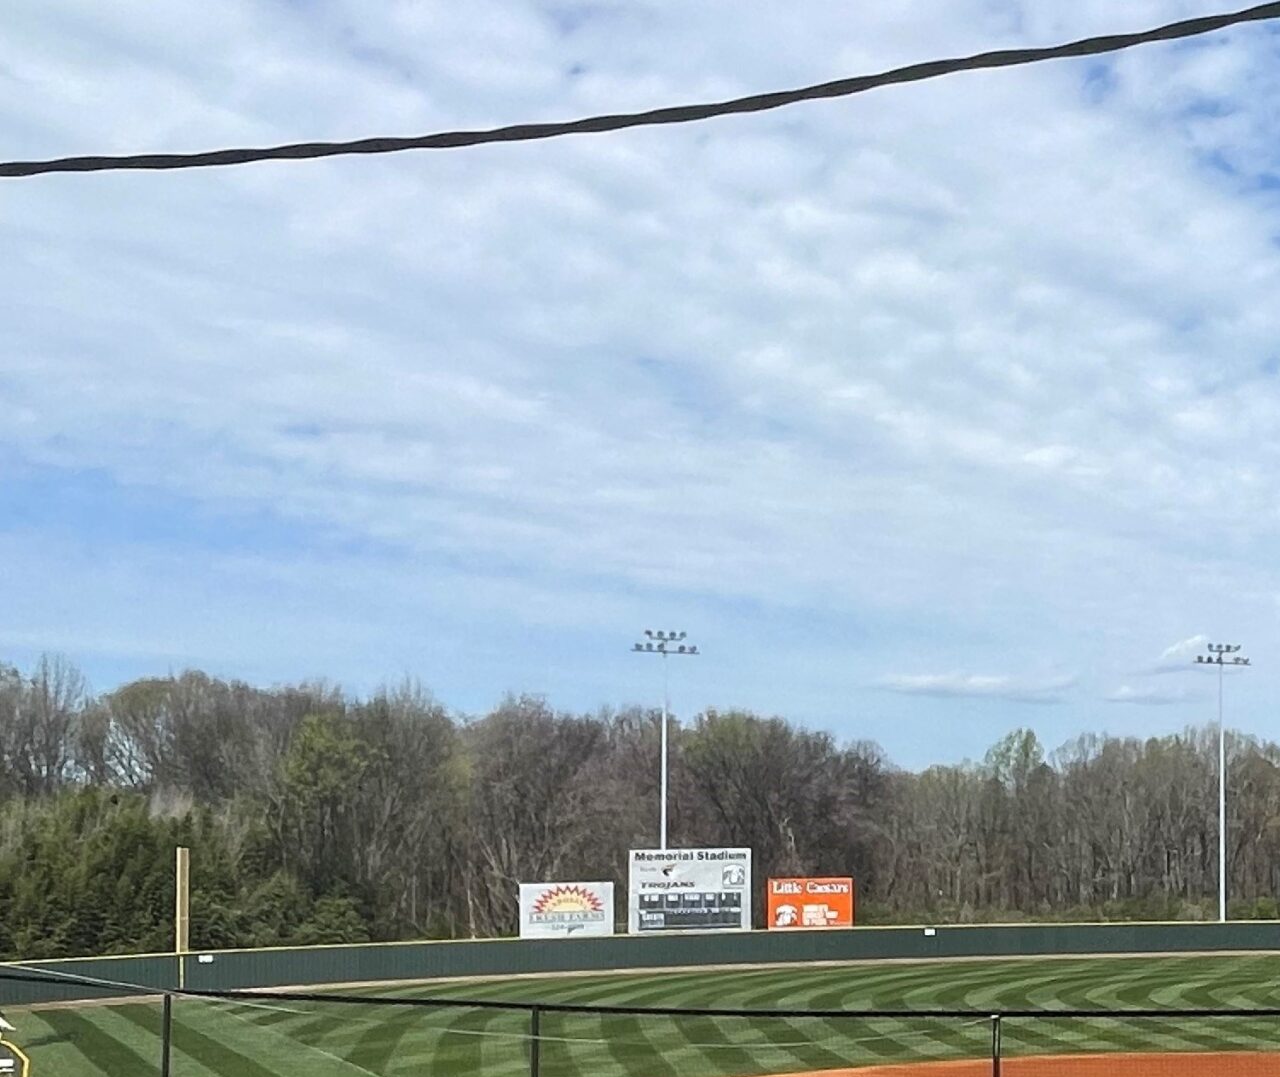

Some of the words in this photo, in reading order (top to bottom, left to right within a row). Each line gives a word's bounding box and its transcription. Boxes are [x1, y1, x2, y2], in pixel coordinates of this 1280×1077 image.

[634, 851, 694, 861] Memorial
[697, 851, 747, 860] Stadium
[641, 881, 696, 890] TROJANS
[772, 881, 803, 894] Little
